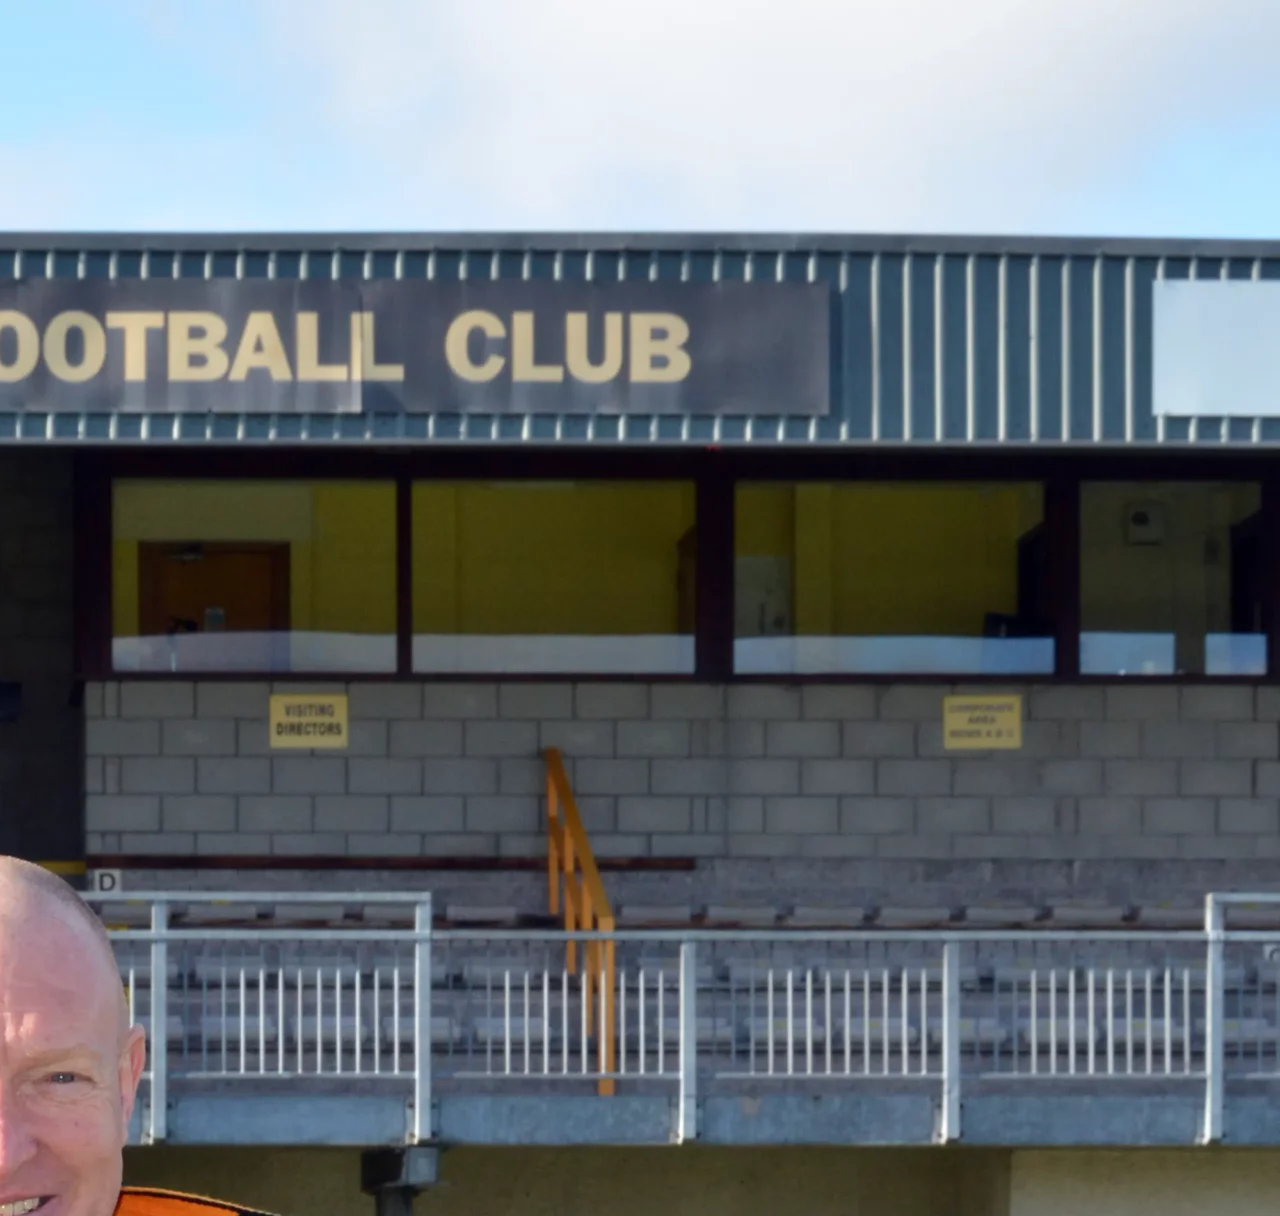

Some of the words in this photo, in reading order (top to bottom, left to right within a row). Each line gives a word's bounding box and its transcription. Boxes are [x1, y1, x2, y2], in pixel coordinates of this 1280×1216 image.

[444, 309, 691, 384] CLUB
[284, 703, 335, 718] VISITING
[276, 721, 343, 736] DIRECTORS
[99, 872, 116, 892] D
